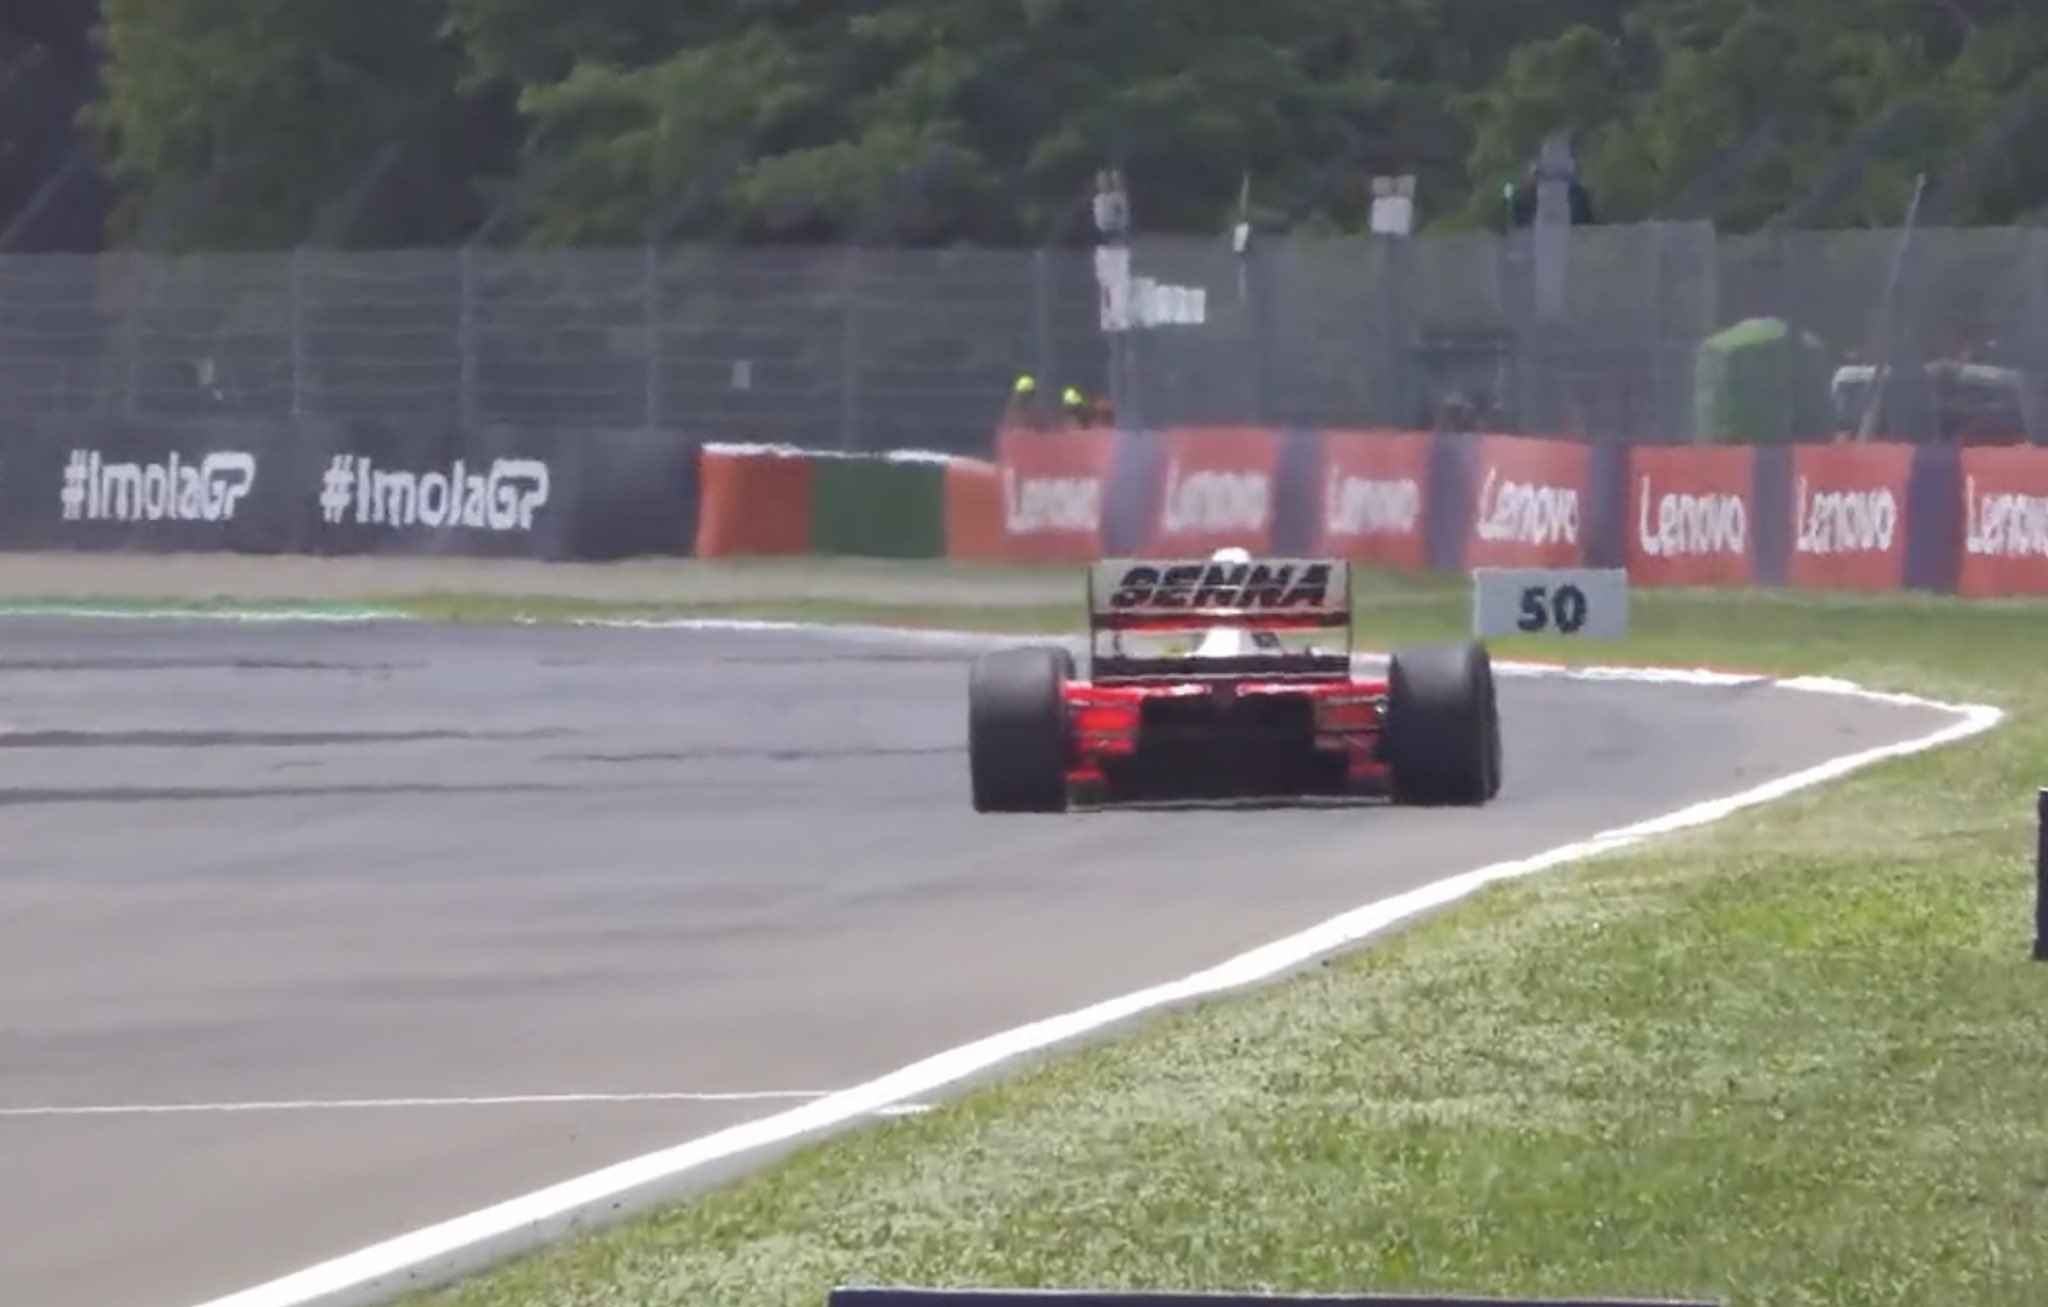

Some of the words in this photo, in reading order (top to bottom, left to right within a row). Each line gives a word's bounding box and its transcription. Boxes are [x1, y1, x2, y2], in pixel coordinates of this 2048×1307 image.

[61, 449, 256, 520] #ImolaGP
[320, 454, 550, 530] #ImolaGP
[1475, 466, 1579, 546] Lenovo
[1639, 475, 1748, 556] Lenovo
[1795, 474, 1896, 555] Lenovo
[1110, 564, 1333, 608] SENNA
[1516, 584, 1588, 635] 50
